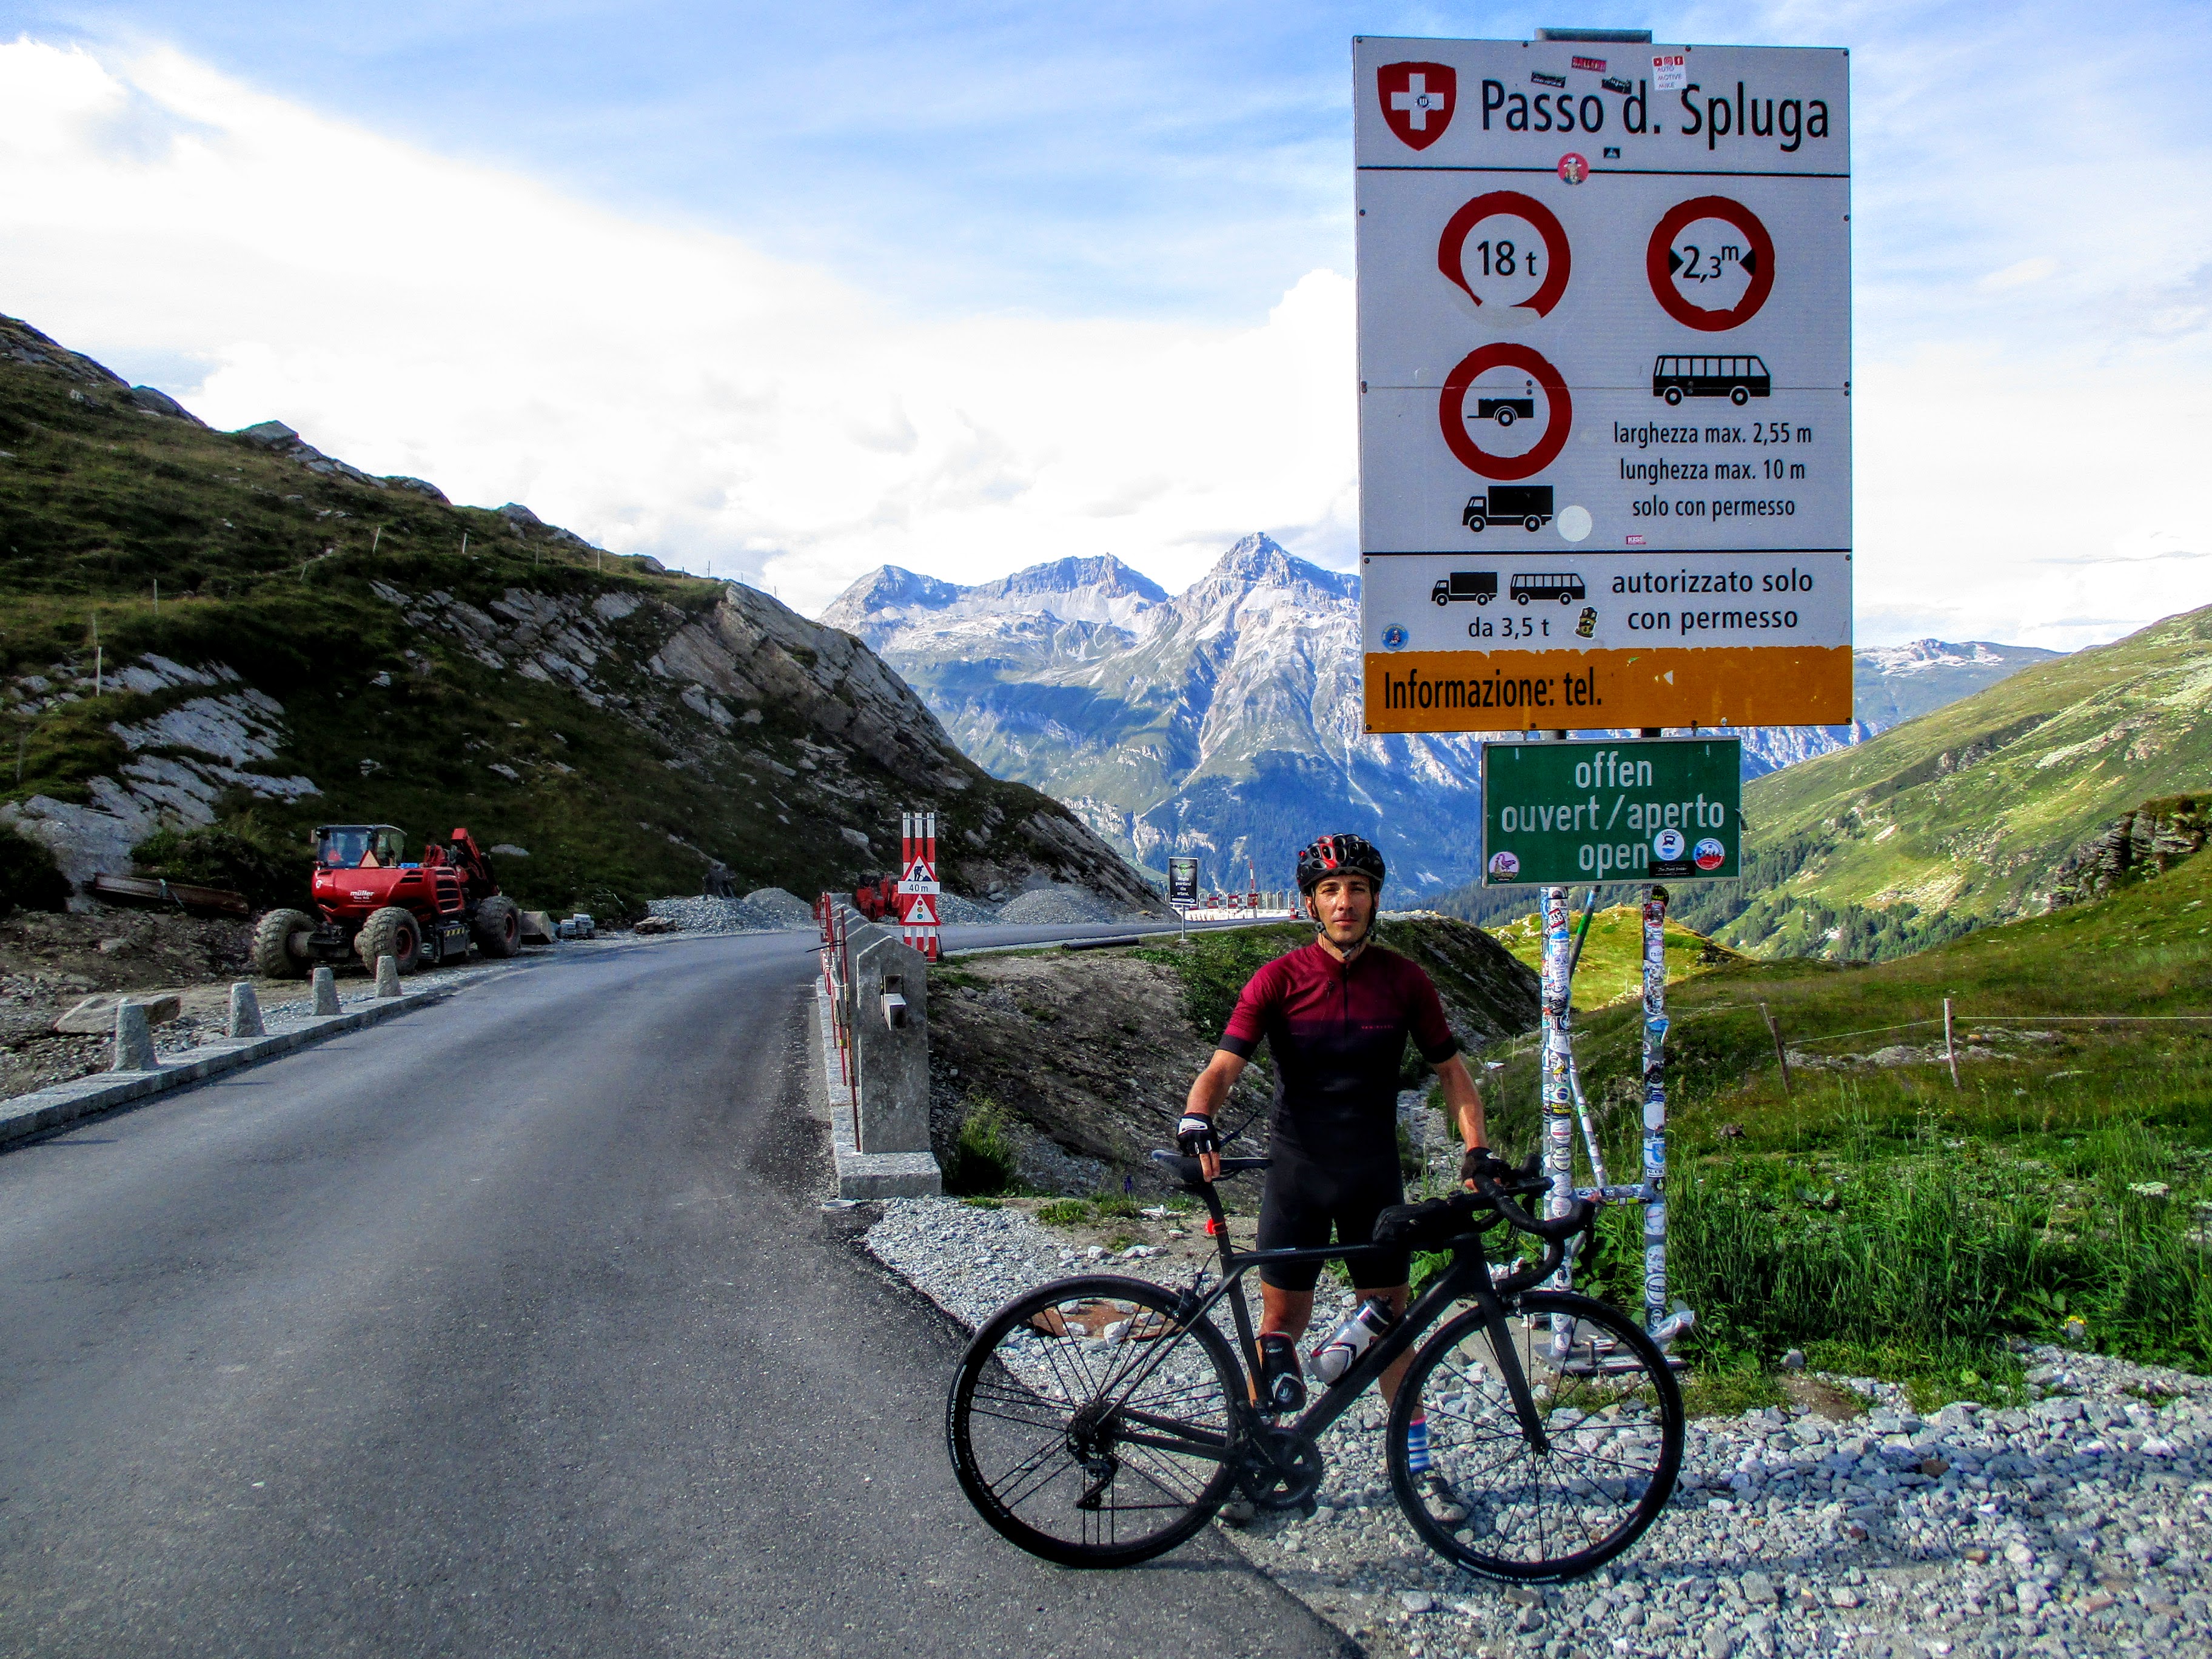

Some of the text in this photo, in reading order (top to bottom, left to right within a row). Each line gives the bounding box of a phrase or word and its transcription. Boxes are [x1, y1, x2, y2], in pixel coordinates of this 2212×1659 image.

[1482, 79, 1829, 153] Passo d. Spluga
[1476, 240, 1537, 276] 18 t
[1614, 421, 1812, 449] larghezza max. 2,55 m
[1620, 457, 1805, 486] lunghezza max. 10 m
[1632, 494, 1795, 522] solo con permesso
[1612, 568, 1813, 594] autorizzato solo
[1468, 616, 1549, 640] da 3,5 t
[1627, 611, 1798, 636] con permesso
[1385, 666, 1601, 709] Informazione: tel.
[1575, 751, 1652, 788] offen
[1578, 842, 1649, 879] open
